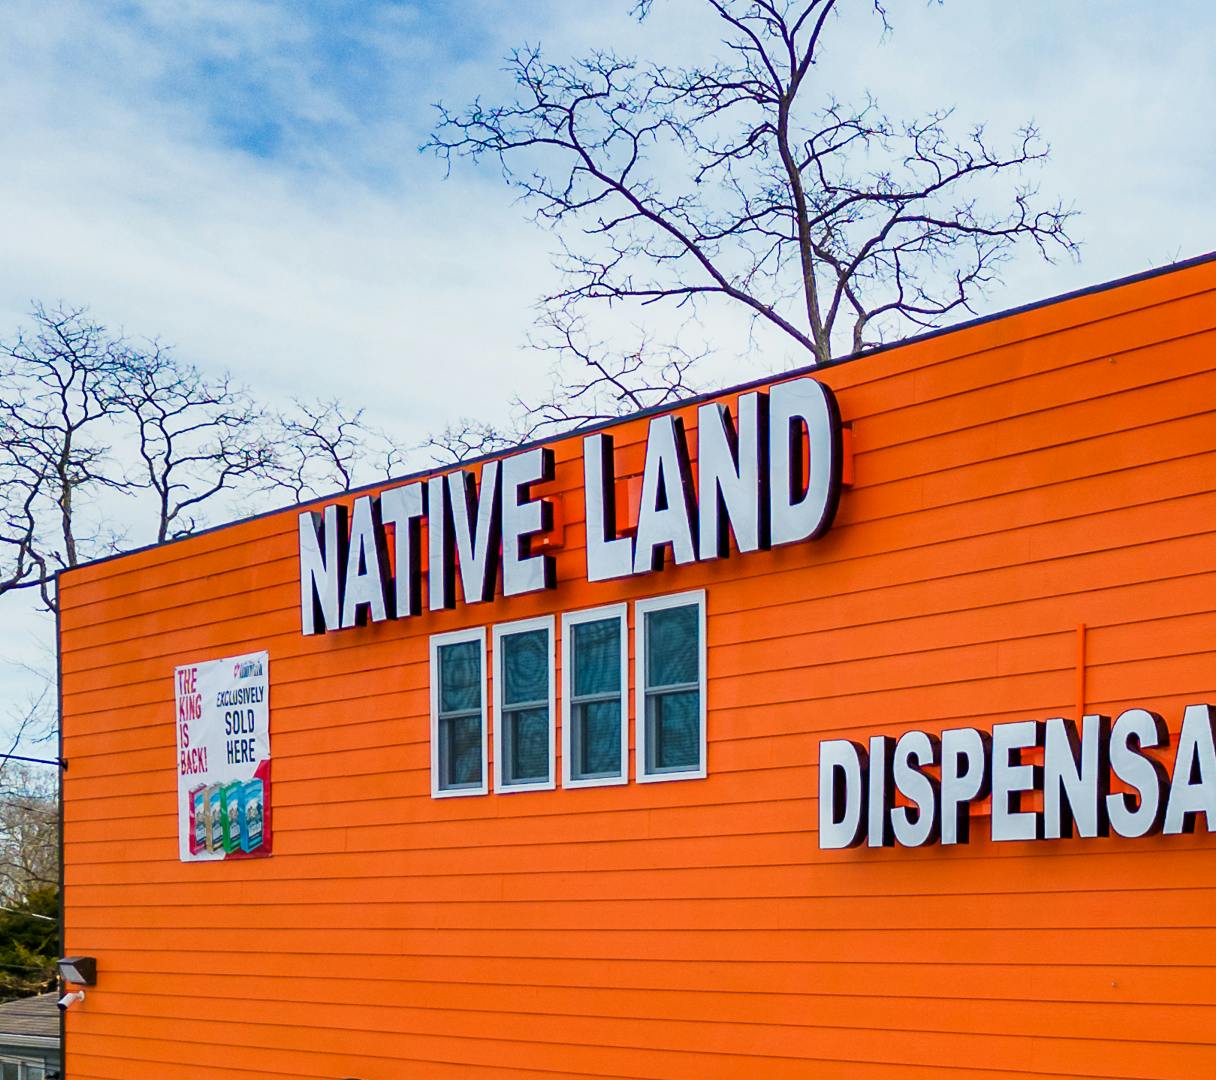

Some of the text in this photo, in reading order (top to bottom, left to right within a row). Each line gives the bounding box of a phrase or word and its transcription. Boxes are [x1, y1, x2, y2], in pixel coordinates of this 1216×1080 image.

[299, 377, 839, 636] NATIVE LAND
[178, 667, 198, 695] THE
[179, 693, 202, 721] KING
[216, 685, 265, 707] EXCLUSIVELY
[225, 709, 255, 735] SOLD
[180, 723, 189, 749] IS
[181, 746, 208, 775] BACK!
[226, 738, 256, 764] HERE
